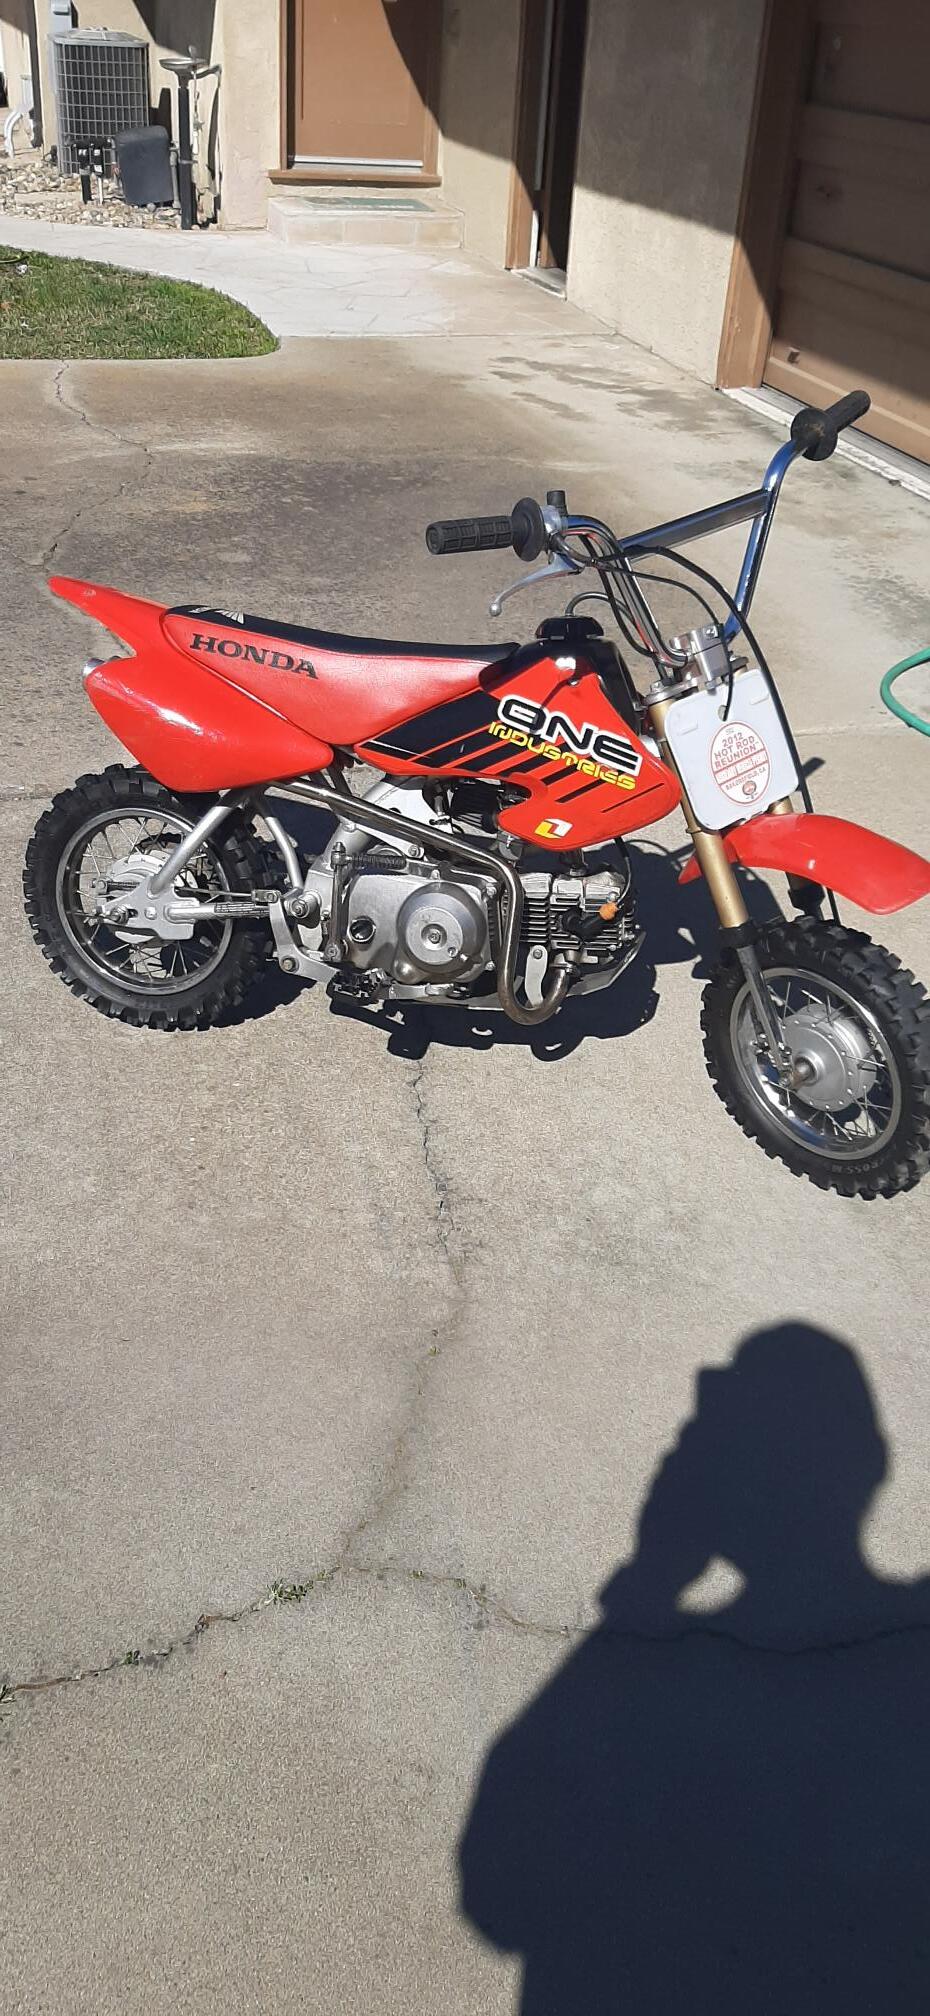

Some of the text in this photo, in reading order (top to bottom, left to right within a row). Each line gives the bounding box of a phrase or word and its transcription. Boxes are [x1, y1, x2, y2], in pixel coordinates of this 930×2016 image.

[189, 632, 319, 680] HONDA
[499, 696, 641, 774] ONE
[714, 736, 755, 760] HOT ROD
[722, 732, 743, 747] 2012
[488, 721, 637, 791] INDUSTRIES
[715, 744, 756, 768] REUNION
